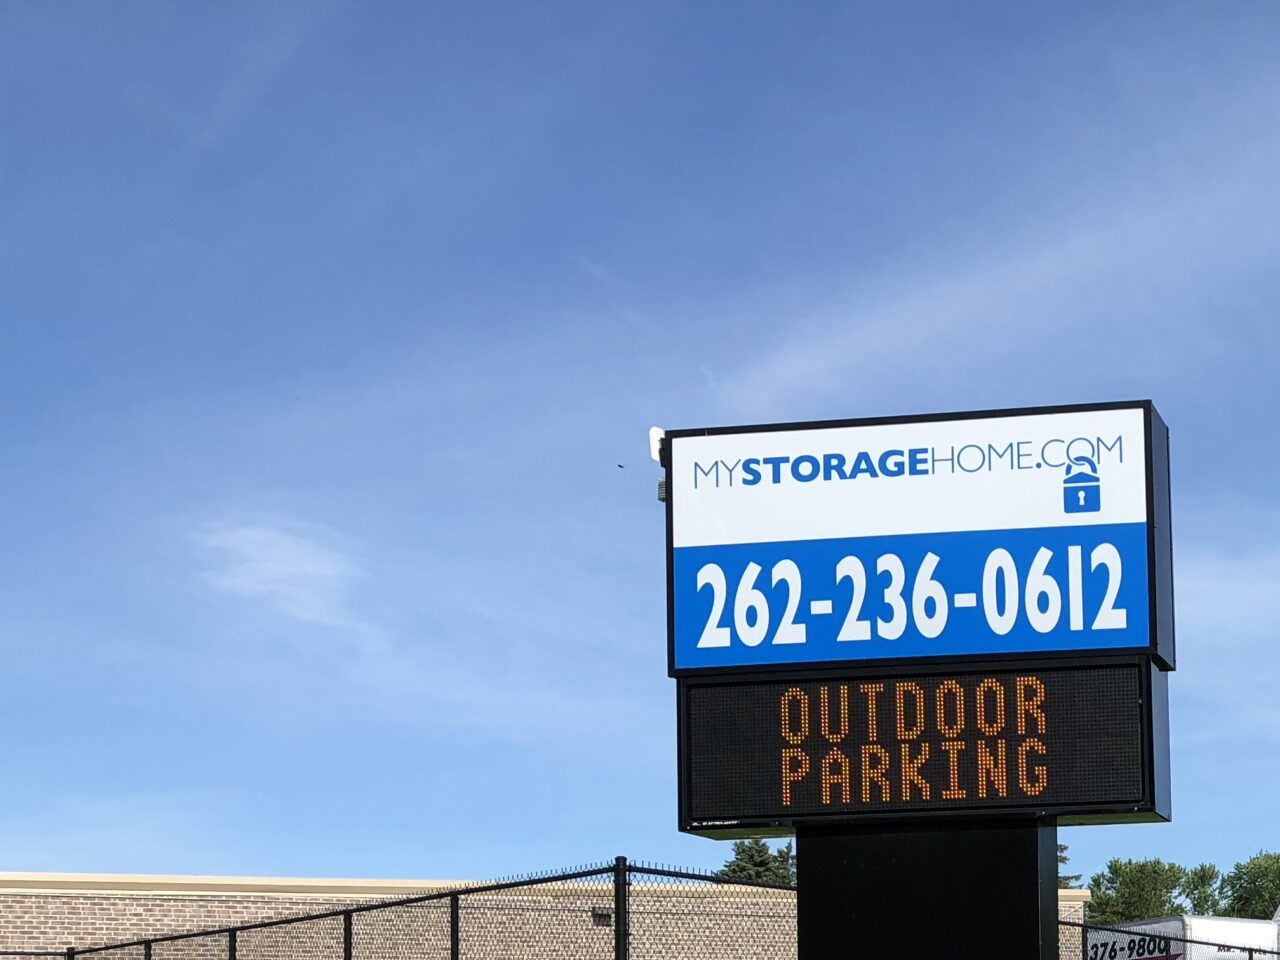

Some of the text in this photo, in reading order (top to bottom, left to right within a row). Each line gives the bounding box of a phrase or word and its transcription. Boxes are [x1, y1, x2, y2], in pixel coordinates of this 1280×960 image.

[694, 435, 1123, 489] MYSTORAGEHOME.COM
[697, 543, 1127, 648] 262-236-0612
[781, 676, 1046, 744] OUTDOOR
[782, 738, 1047, 805] PARKING
